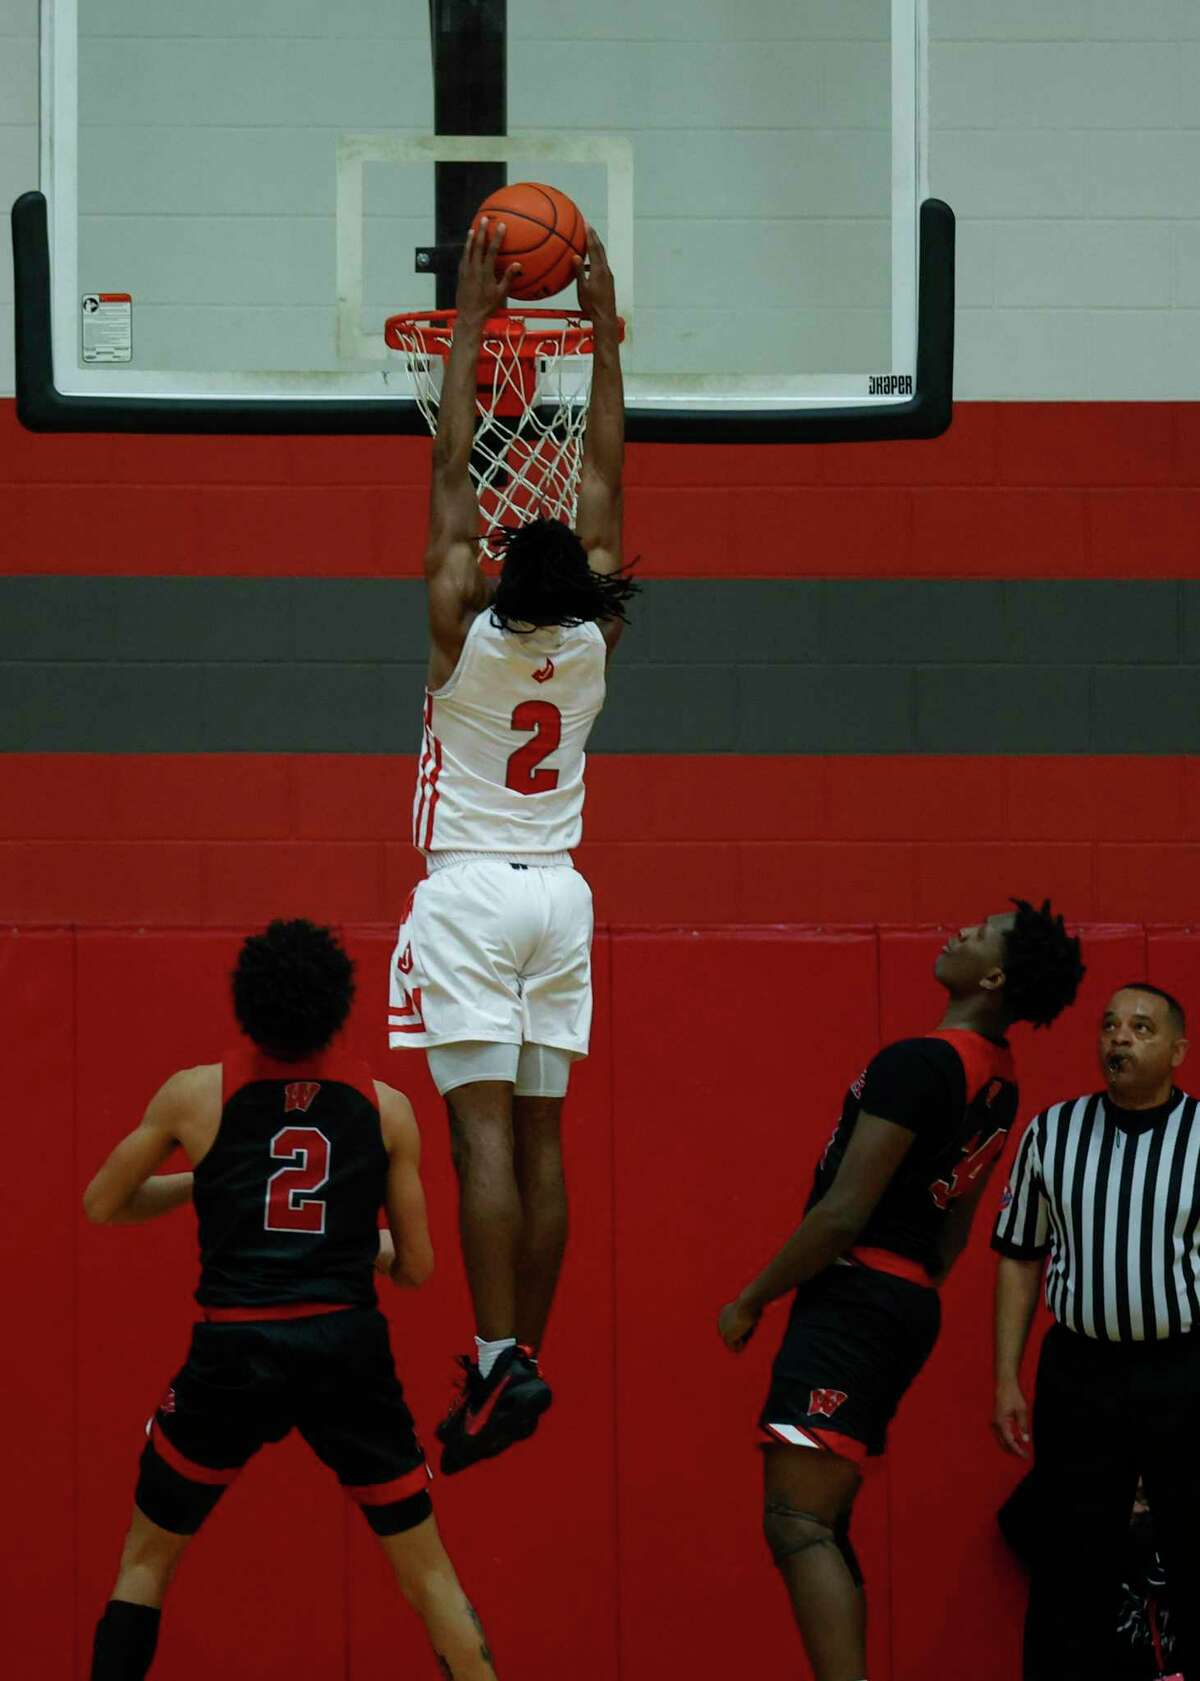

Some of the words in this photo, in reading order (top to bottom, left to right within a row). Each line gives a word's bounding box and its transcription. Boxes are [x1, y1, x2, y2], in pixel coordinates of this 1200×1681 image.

[505, 700, 562, 795] 2
[284, 1081, 321, 1113] W
[264, 1126, 332, 1234] 2
